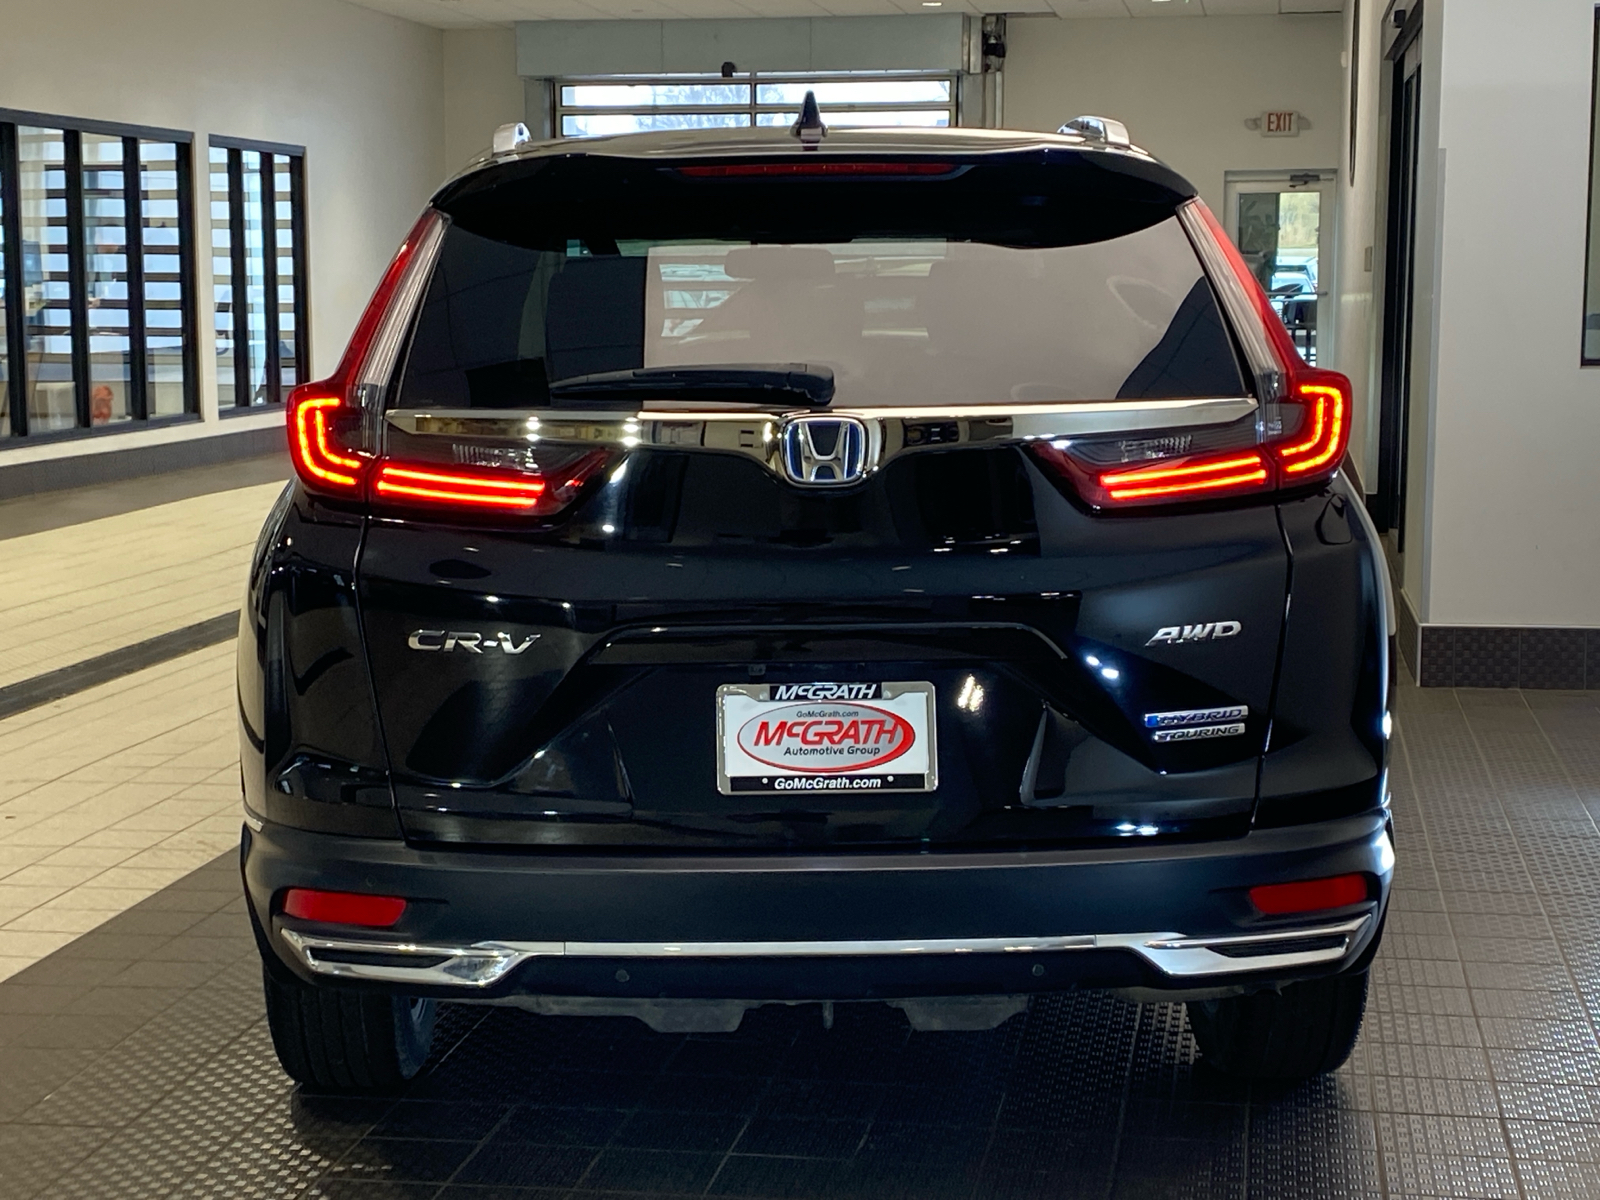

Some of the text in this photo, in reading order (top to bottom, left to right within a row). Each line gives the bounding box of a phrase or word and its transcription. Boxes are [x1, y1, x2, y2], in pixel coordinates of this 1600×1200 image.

[1267, 112, 1294, 132] EXIT
[408, 629, 541, 654] CR-V
[1145, 620, 1242, 647] AWD
[796, 710, 859, 719] GoMcGrath.com
[1159, 708, 1243, 725] HYBRID
[1158, 725, 1240, 741] TOURING
[783, 745, 881, 757] Automotive Group
[774, 777, 882, 790] GoMcGrath.com
